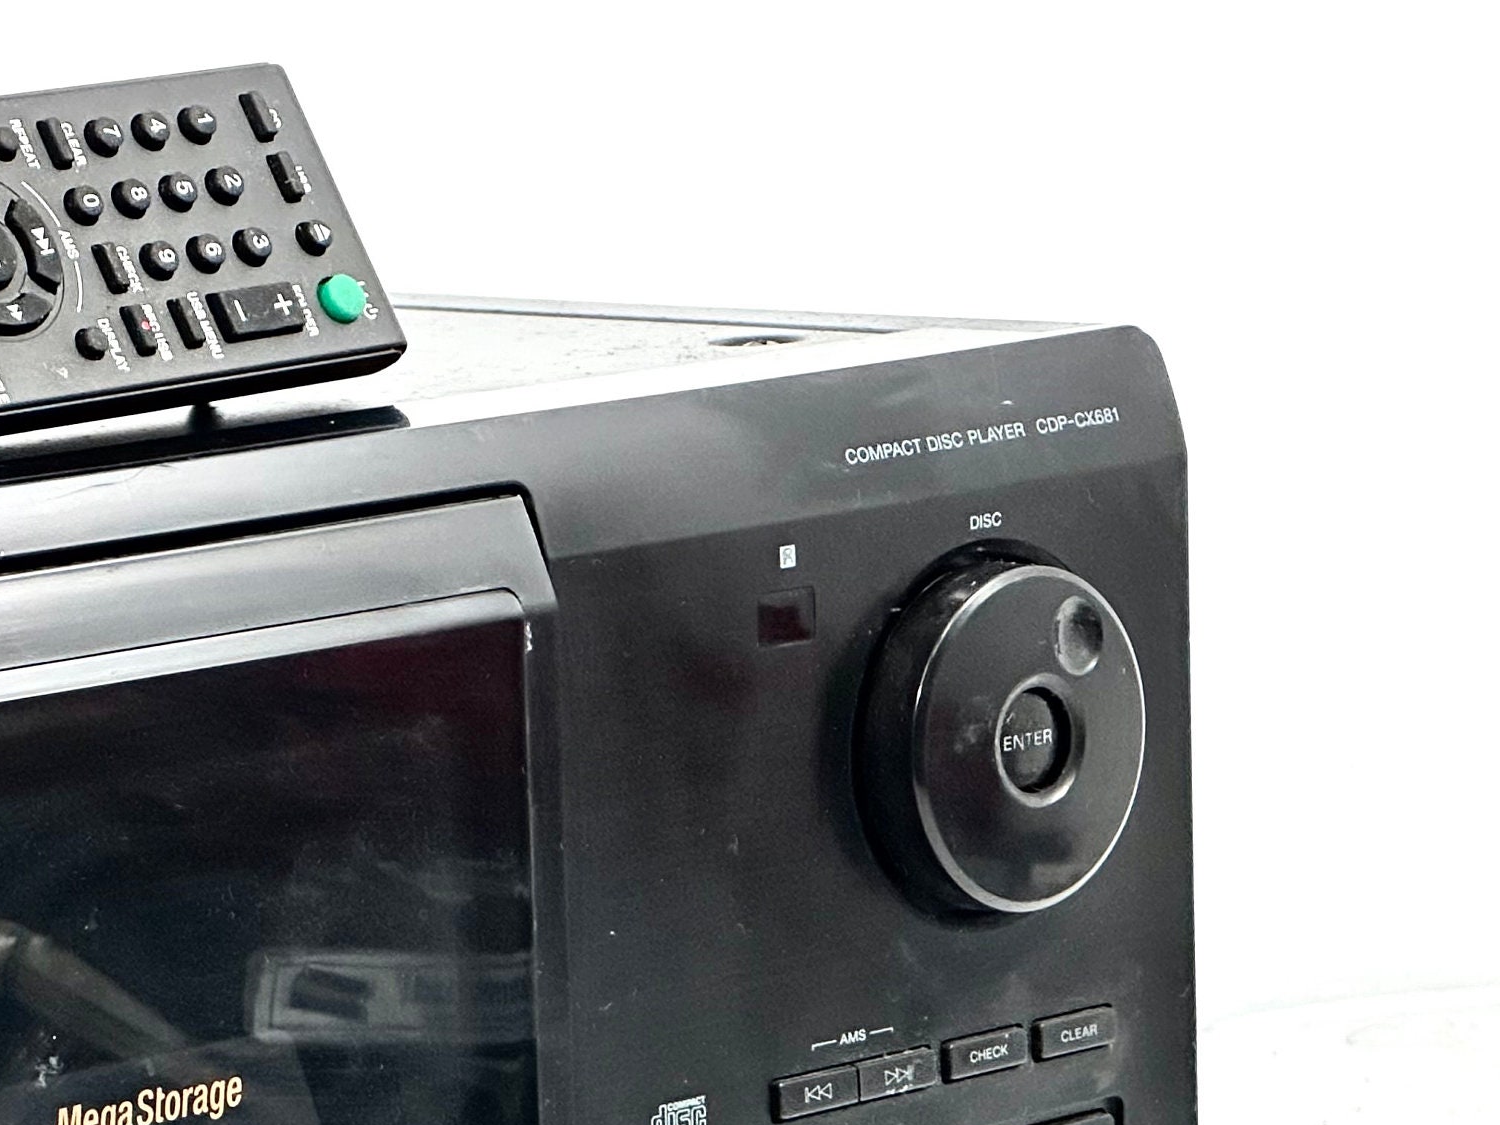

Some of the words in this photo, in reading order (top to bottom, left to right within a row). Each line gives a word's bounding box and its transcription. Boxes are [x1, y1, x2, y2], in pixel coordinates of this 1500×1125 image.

[150, 118, 167, 133] 4
[197, 112, 214, 124] 1
[102, 124, 122, 138] 7
[9, 118, 41, 169] REPEAT
[60, 121, 88, 167] CLEAR
[175, 180, 194, 195] 5
[224, 173, 243, 188] 2
[82, 193, 100, 208] 0
[130, 186, 148, 201] 8
[58, 229, 80, 260] AMS
[205, 242, 223, 257] 6
[252, 234, 270, 249] 3
[157, 248, 176, 263] 9
[115, 245, 144, 293] CHECK
[186, 291, 207, 320] USB
[200, 320, 225, 359] MENU
[97, 318, 131, 372] DISPLAY
[844, 438, 922, 466] COMPACT
[926, 429, 965, 452] DISC
[967, 421, 1026, 446] PLAYER
[1035, 406, 1121, 436] CDP-CX681
[969, 511, 1003, 531] DISC
[1002, 727, 1054, 753] ENTER
[839, 1028, 867, 1045] AMS
[1060, 1023, 1099, 1043] CLEAR
[968, 1042, 1010, 1064] CHECK
